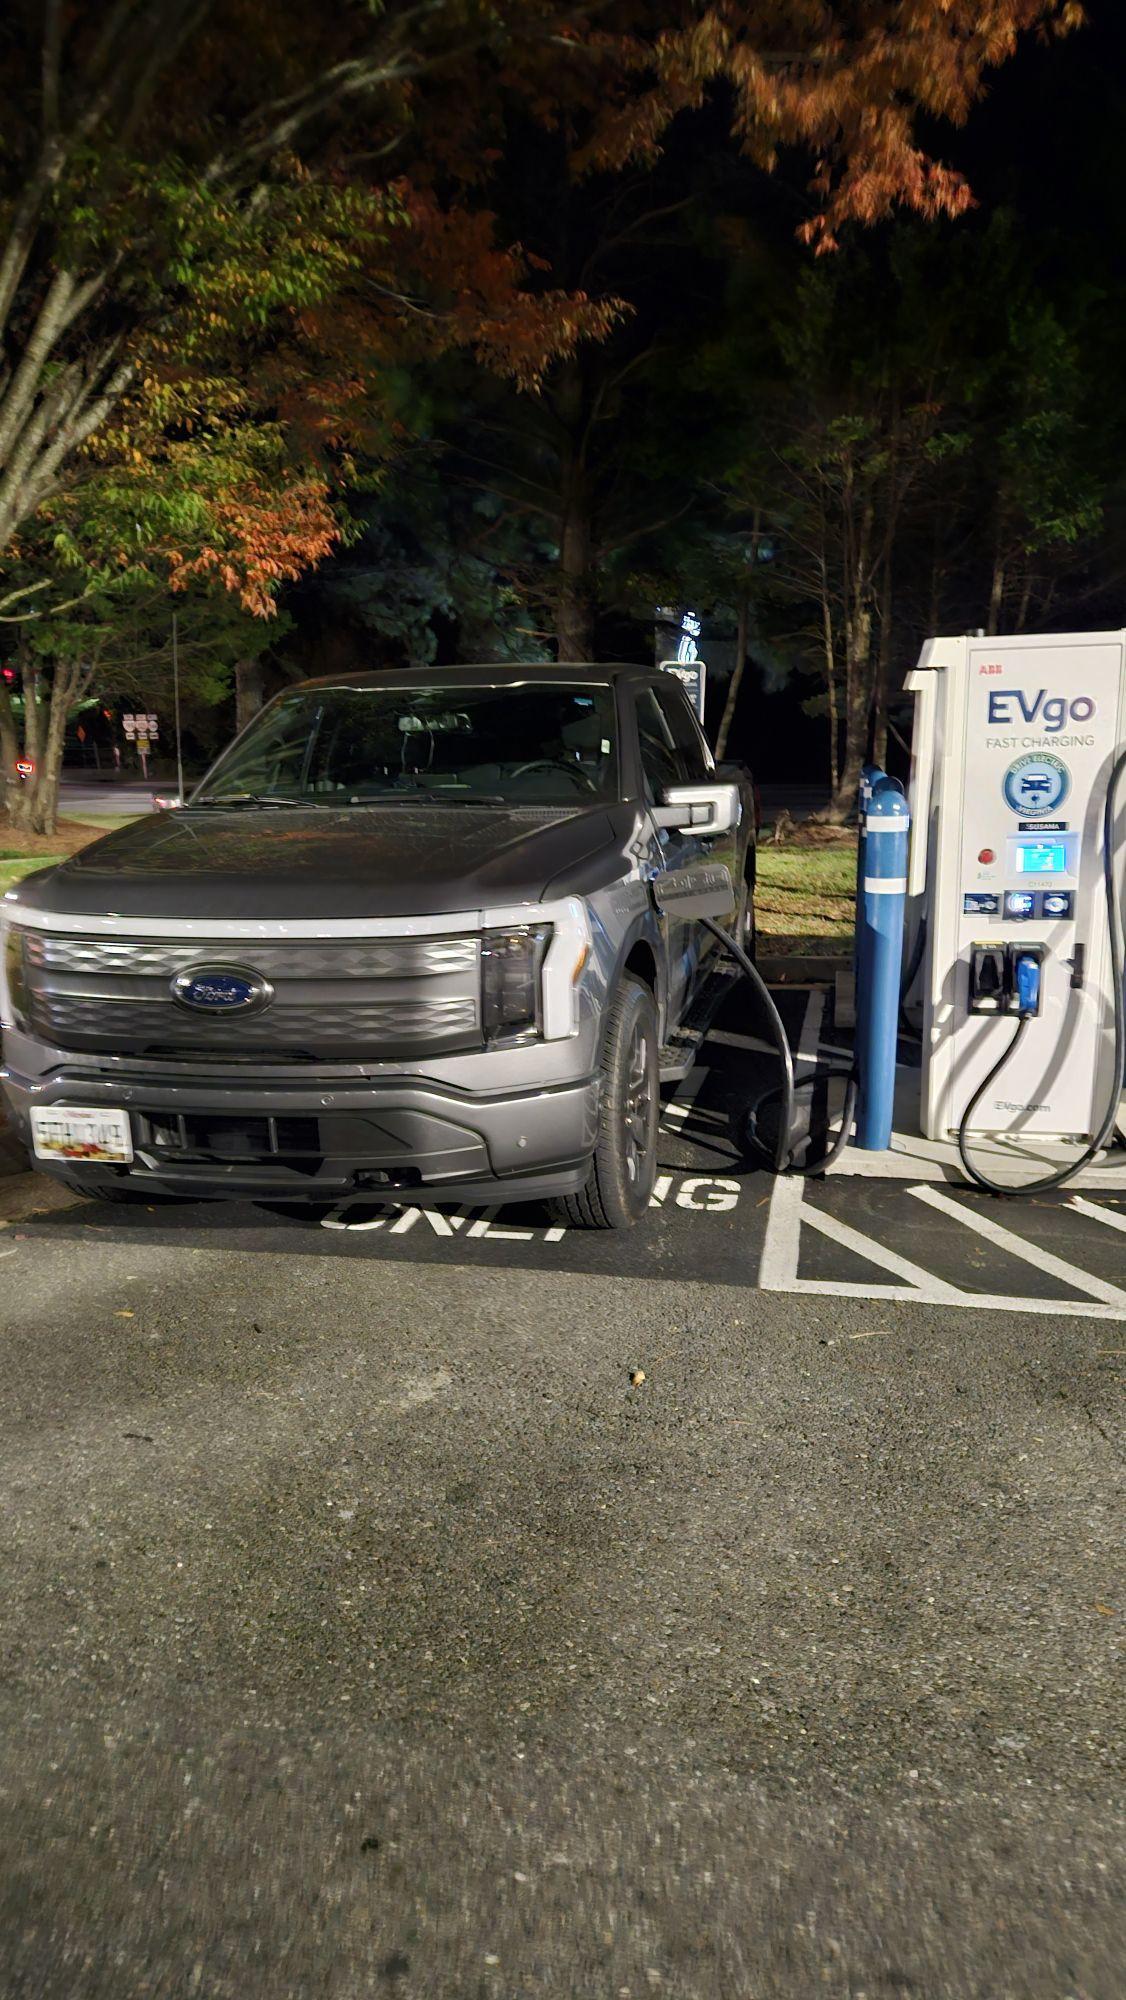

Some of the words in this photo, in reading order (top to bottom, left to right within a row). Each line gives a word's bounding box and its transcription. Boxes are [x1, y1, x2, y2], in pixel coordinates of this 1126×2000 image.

[979, 664, 1003, 675] ABB
[988, 689, 1096, 733] EVgo
[986, 738, 1018, 749] FAST
[1021, 735, 1096, 748] CHARGING
